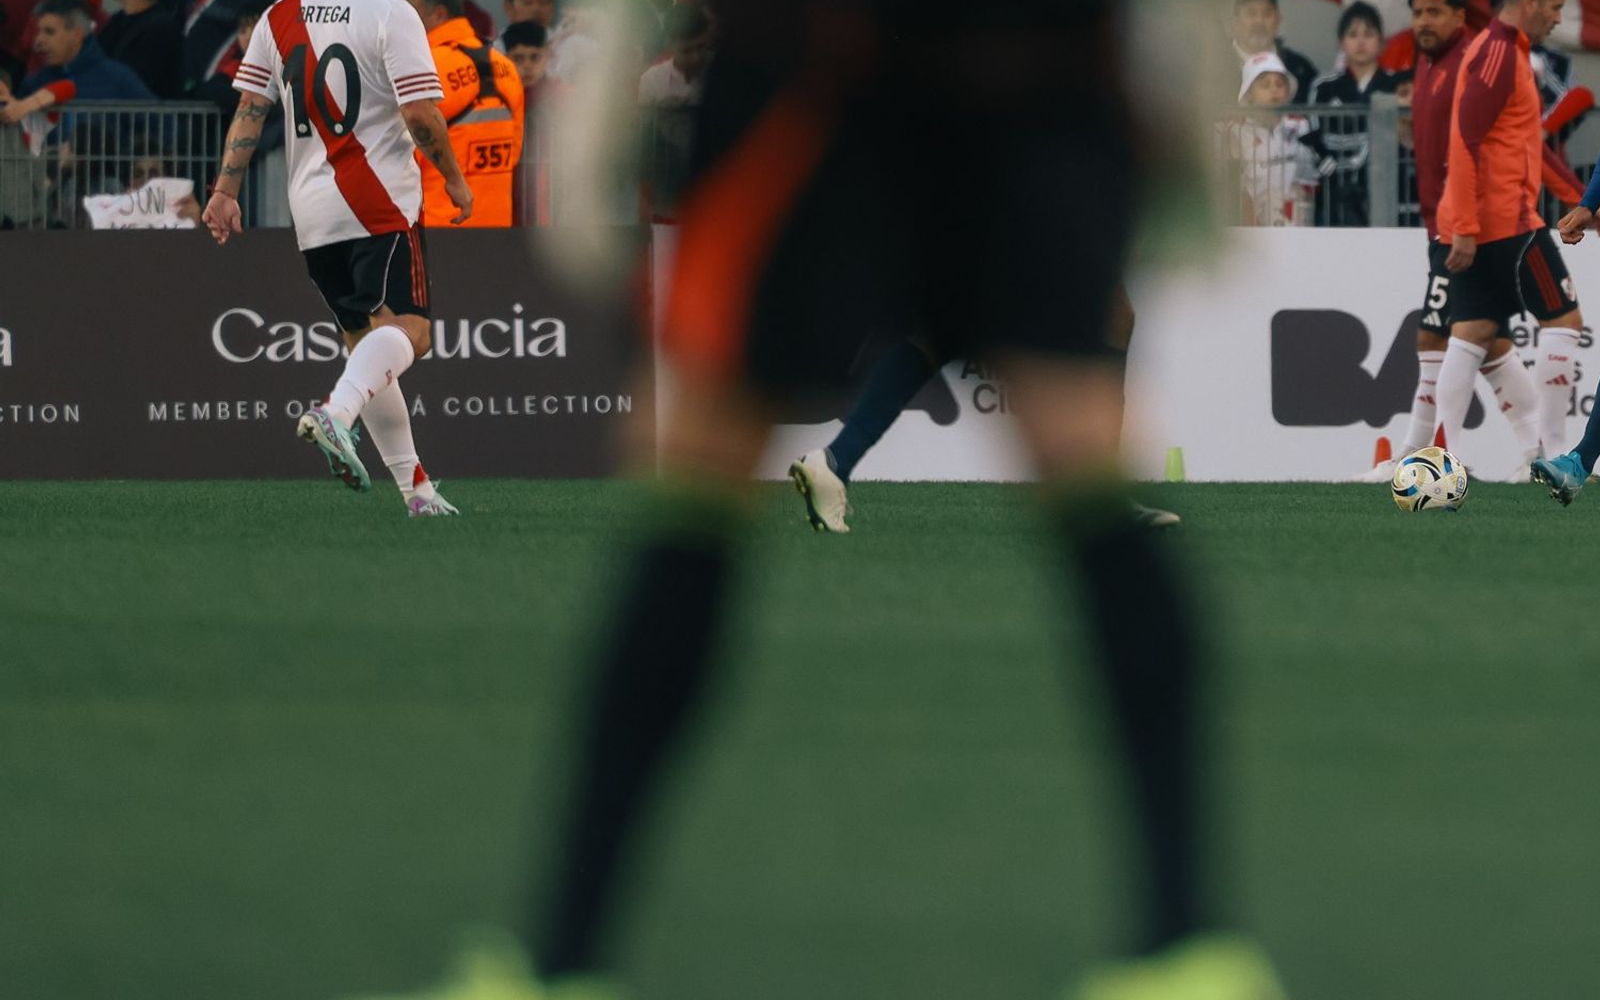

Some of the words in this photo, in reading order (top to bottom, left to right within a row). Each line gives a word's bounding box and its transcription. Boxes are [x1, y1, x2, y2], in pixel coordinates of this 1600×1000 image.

[297, 5, 351, 25] ORTEGA
[282, 43, 361, 139] 10
[475, 144, 513, 170] 357
[1428, 274, 1450, 311] 5
[149, 401, 269, 423] MEMBER
[443, 395, 633, 417] COLLECTION
